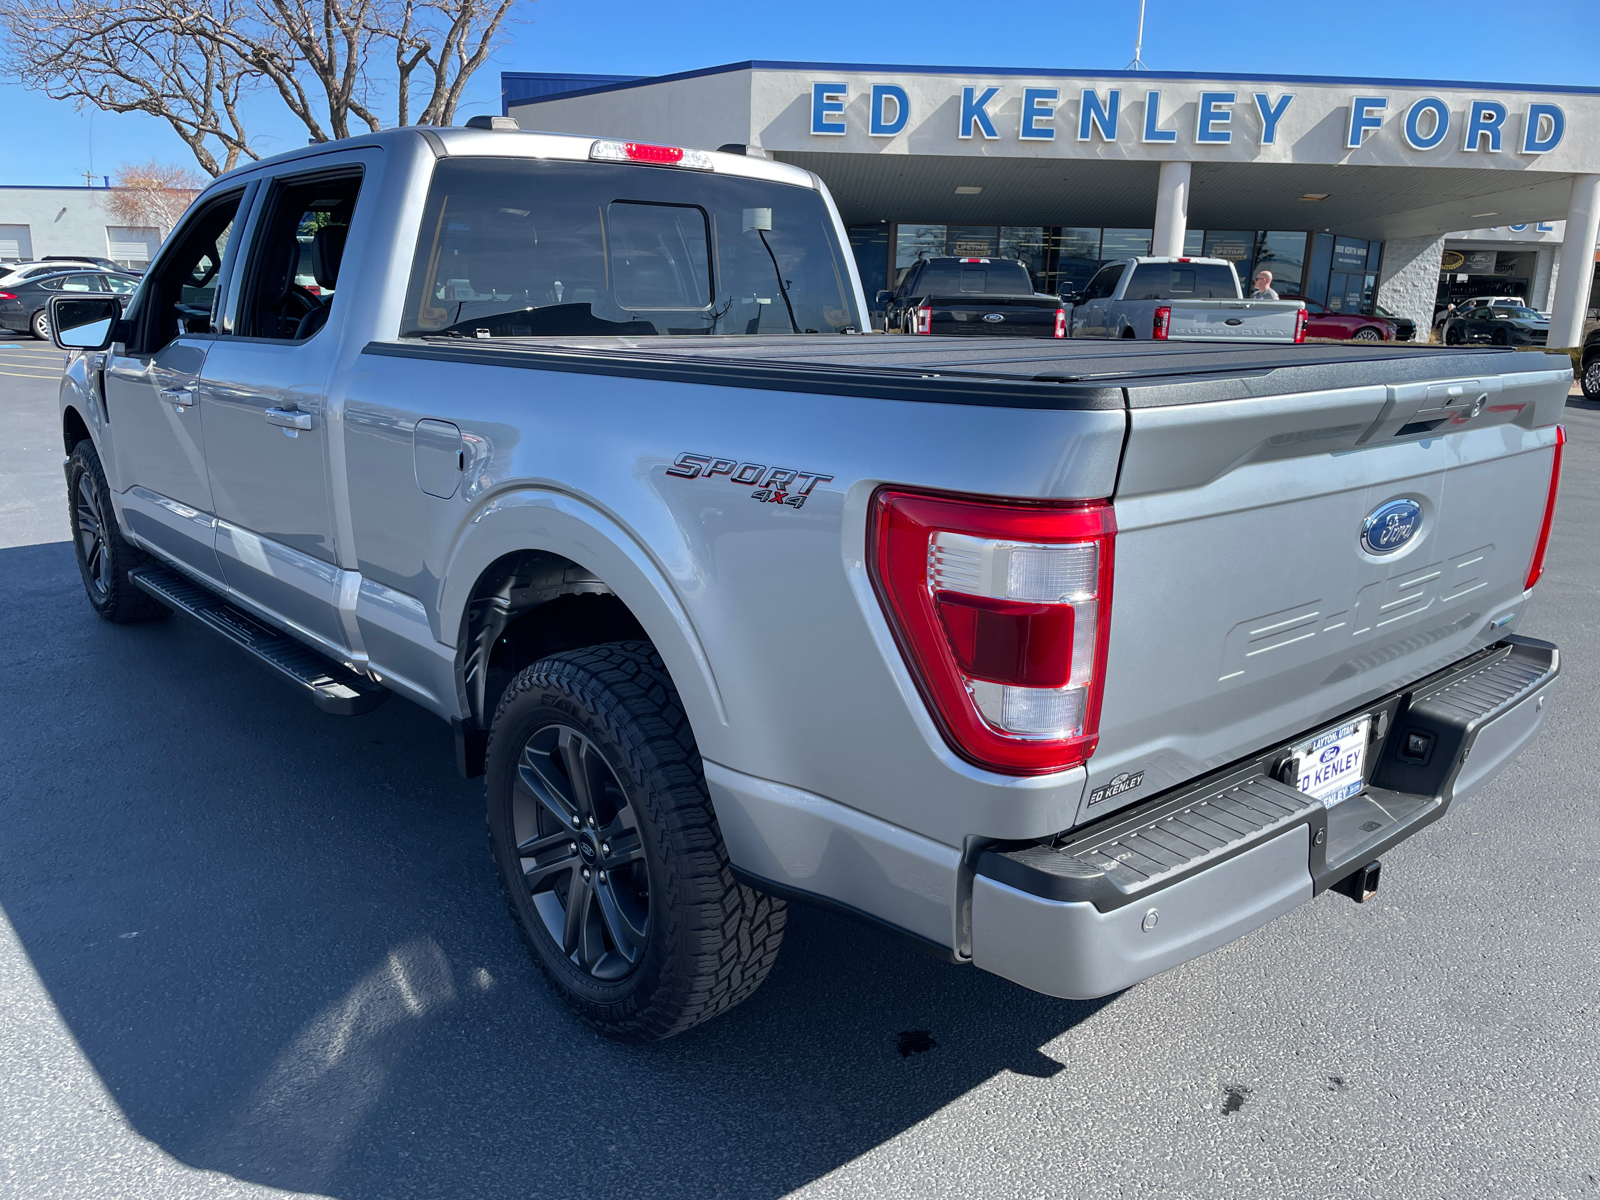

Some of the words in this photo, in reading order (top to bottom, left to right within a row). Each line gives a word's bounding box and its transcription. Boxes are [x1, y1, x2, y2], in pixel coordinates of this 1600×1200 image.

[811, 82, 911, 137] ED
[958, 85, 1297, 146] KENLEY
[1346, 96, 1566, 154] FORD
[665, 452, 835, 496] SPORT
[1379, 511, 1415, 545] Ford
[1313, 731, 1338, 750] LAYTON,
[1339, 723, 1354, 739] UTAH
[1314, 749, 1361, 786] KENLEY
[1090, 791, 1104, 804] ED
[1105, 774, 1144, 798] KENLEY
[1323, 786, 1349, 807] ENLEY
